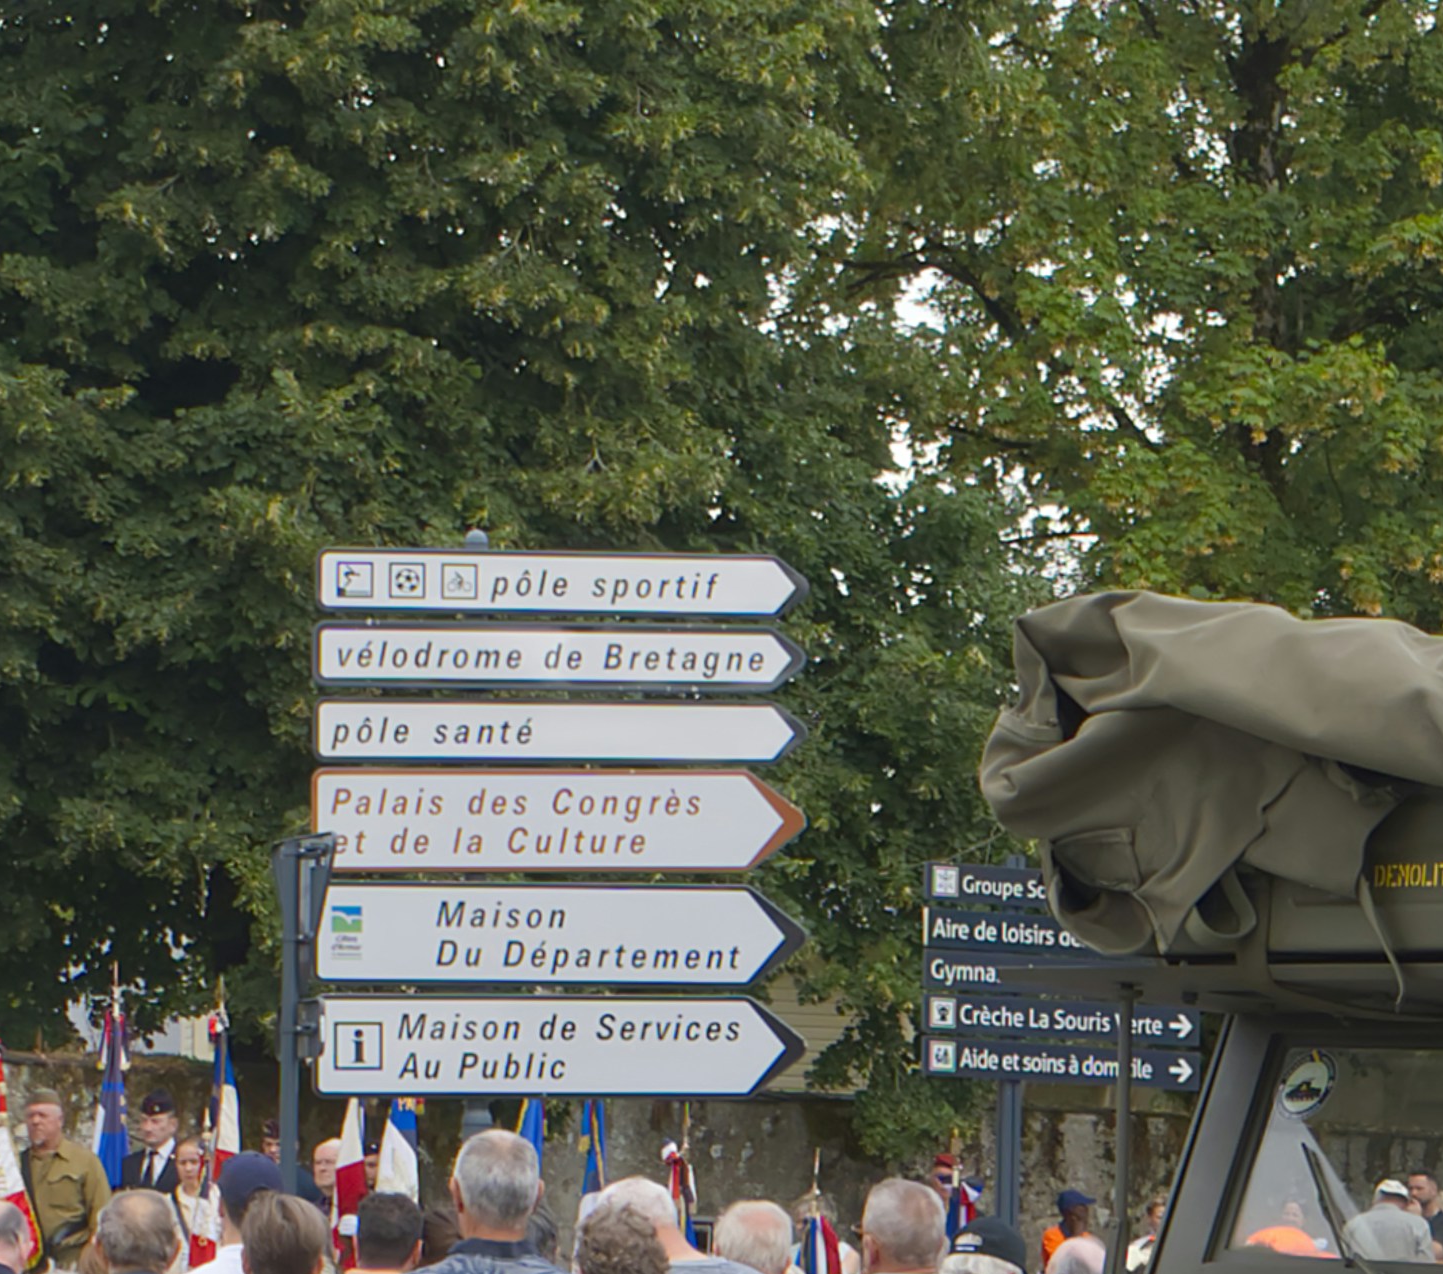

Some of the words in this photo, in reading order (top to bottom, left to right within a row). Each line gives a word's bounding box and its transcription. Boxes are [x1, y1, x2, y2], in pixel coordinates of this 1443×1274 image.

[491, 570, 569, 603] pôle
[591, 573, 720, 605] sportif
[337, 639, 523, 669] vélodrome
[545, 643, 584, 671] de
[603, 643, 765, 678] Bretagne
[331, 716, 410, 750] pôle
[434, 717, 534, 745] santé
[331, 788, 445, 815] Palais
[468, 788, 528, 816] des
[552, 788, 702, 823] Congrès
[334, 831, 366, 854] et
[390, 827, 430, 854] de
[454, 827, 485, 854] la
[508, 827, 647, 854] Culture
[962, 874, 1024, 902] Groupe
[1026, 879, 1048, 900] Sc
[436, 900, 567, 929] Maison
[932, 917, 970, 940] Aire
[974, 920, 998, 942] de
[1002, 922, 1056, 946] loisirs
[436, 939, 482, 966] Du
[504, 939, 741, 975] Département
[930, 958, 1002, 987] Gymna
[398, 1013, 521, 1041] Maison
[539, 1014, 577, 1042] de
[596, 1014, 741, 1042] Services
[959, 1004, 1025, 1029] Crèche
[1028, 1007, 1051, 1029] La
[1054, 1008, 1111, 1033] Souris
[399, 1051, 442, 1080] Au
[459, 1052, 567, 1080] Public
[959, 1048, 999, 1070] Aide
[1002, 1051, 1020, 1071] et
[1023, 1051, 1066, 1074] soins
[1067, 1051, 1079, 1074] à
[1082, 1054, 1153, 1080] domile
